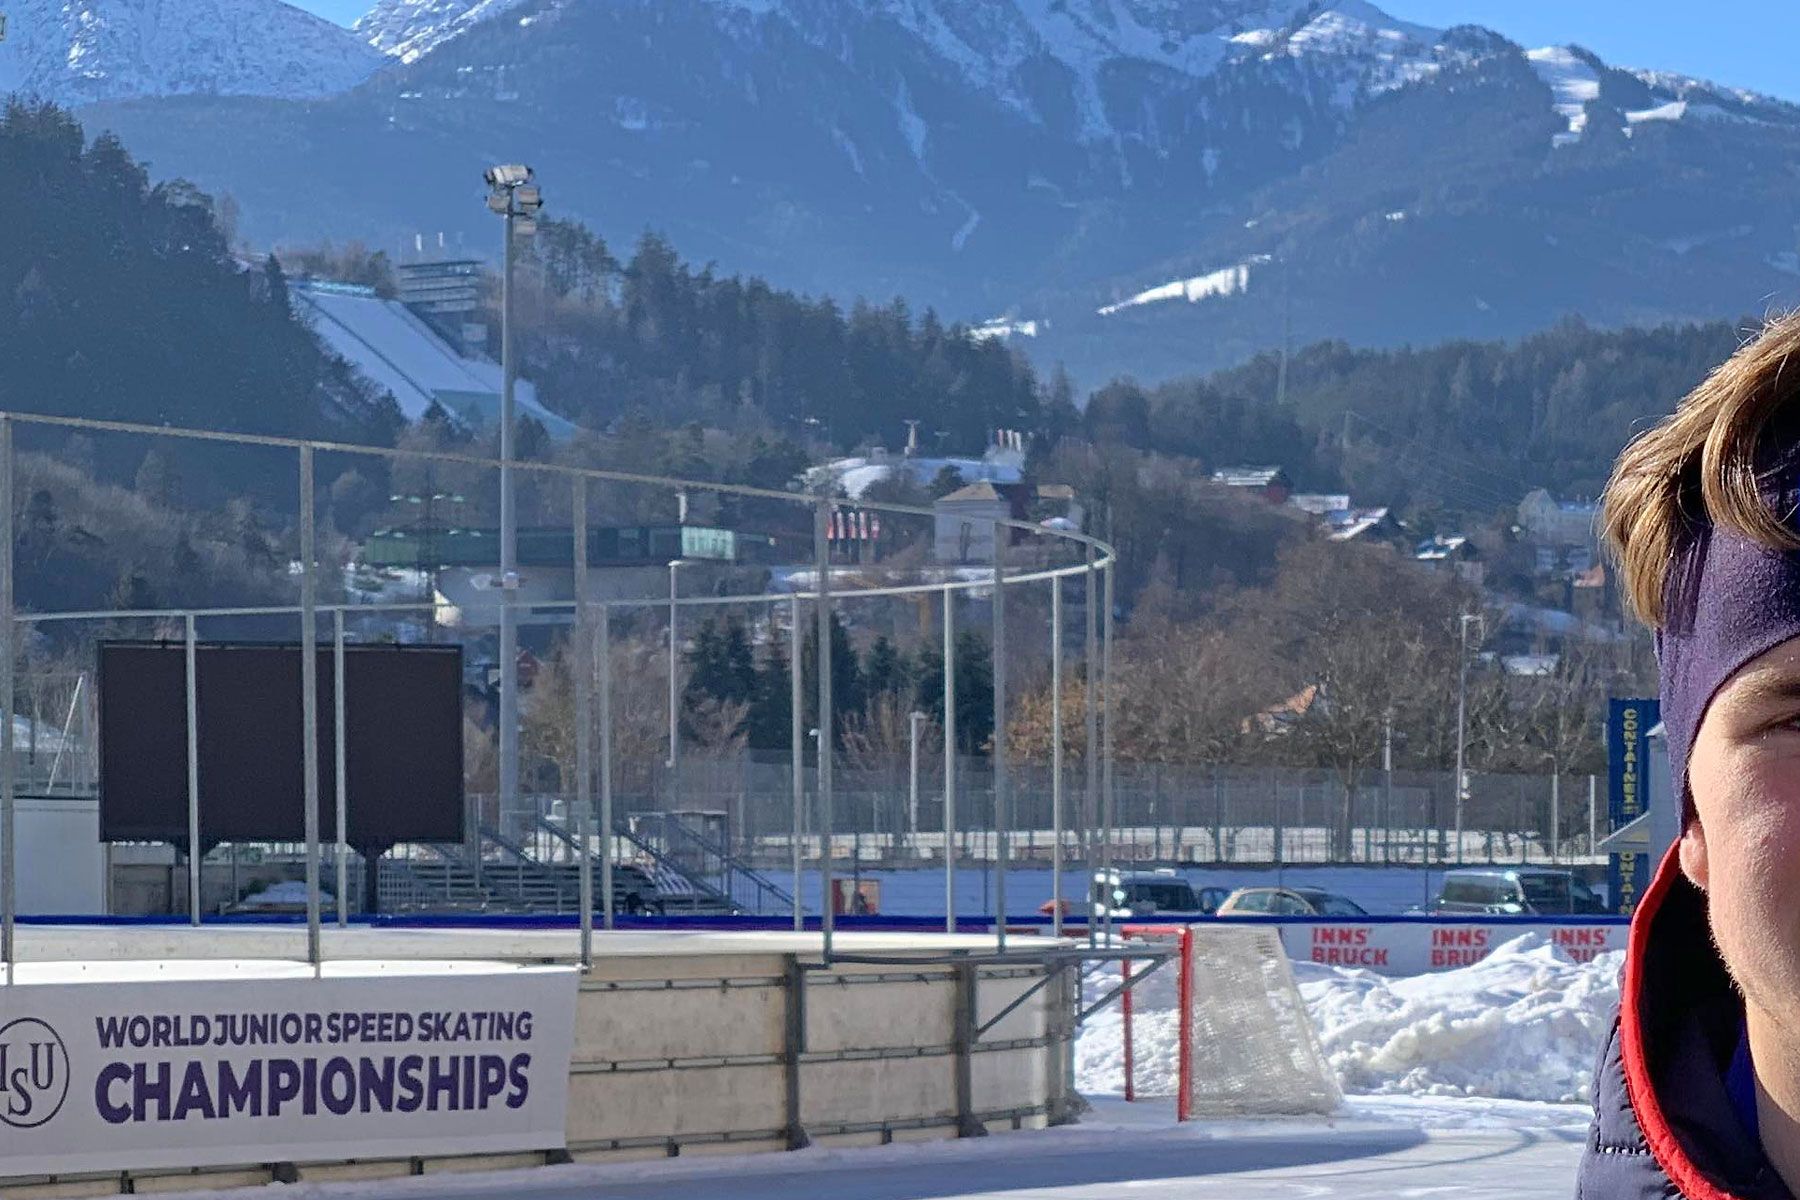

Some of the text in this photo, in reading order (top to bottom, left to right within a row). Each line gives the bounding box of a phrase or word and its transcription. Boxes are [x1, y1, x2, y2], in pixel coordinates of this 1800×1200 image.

[1311, 949, 1388, 966] BRUCK
[95, 1010, 533, 1048] WORLD JUNIOR SPEED SKATING
[94, 1052, 532, 1124] CHAMPIONSHIPS
